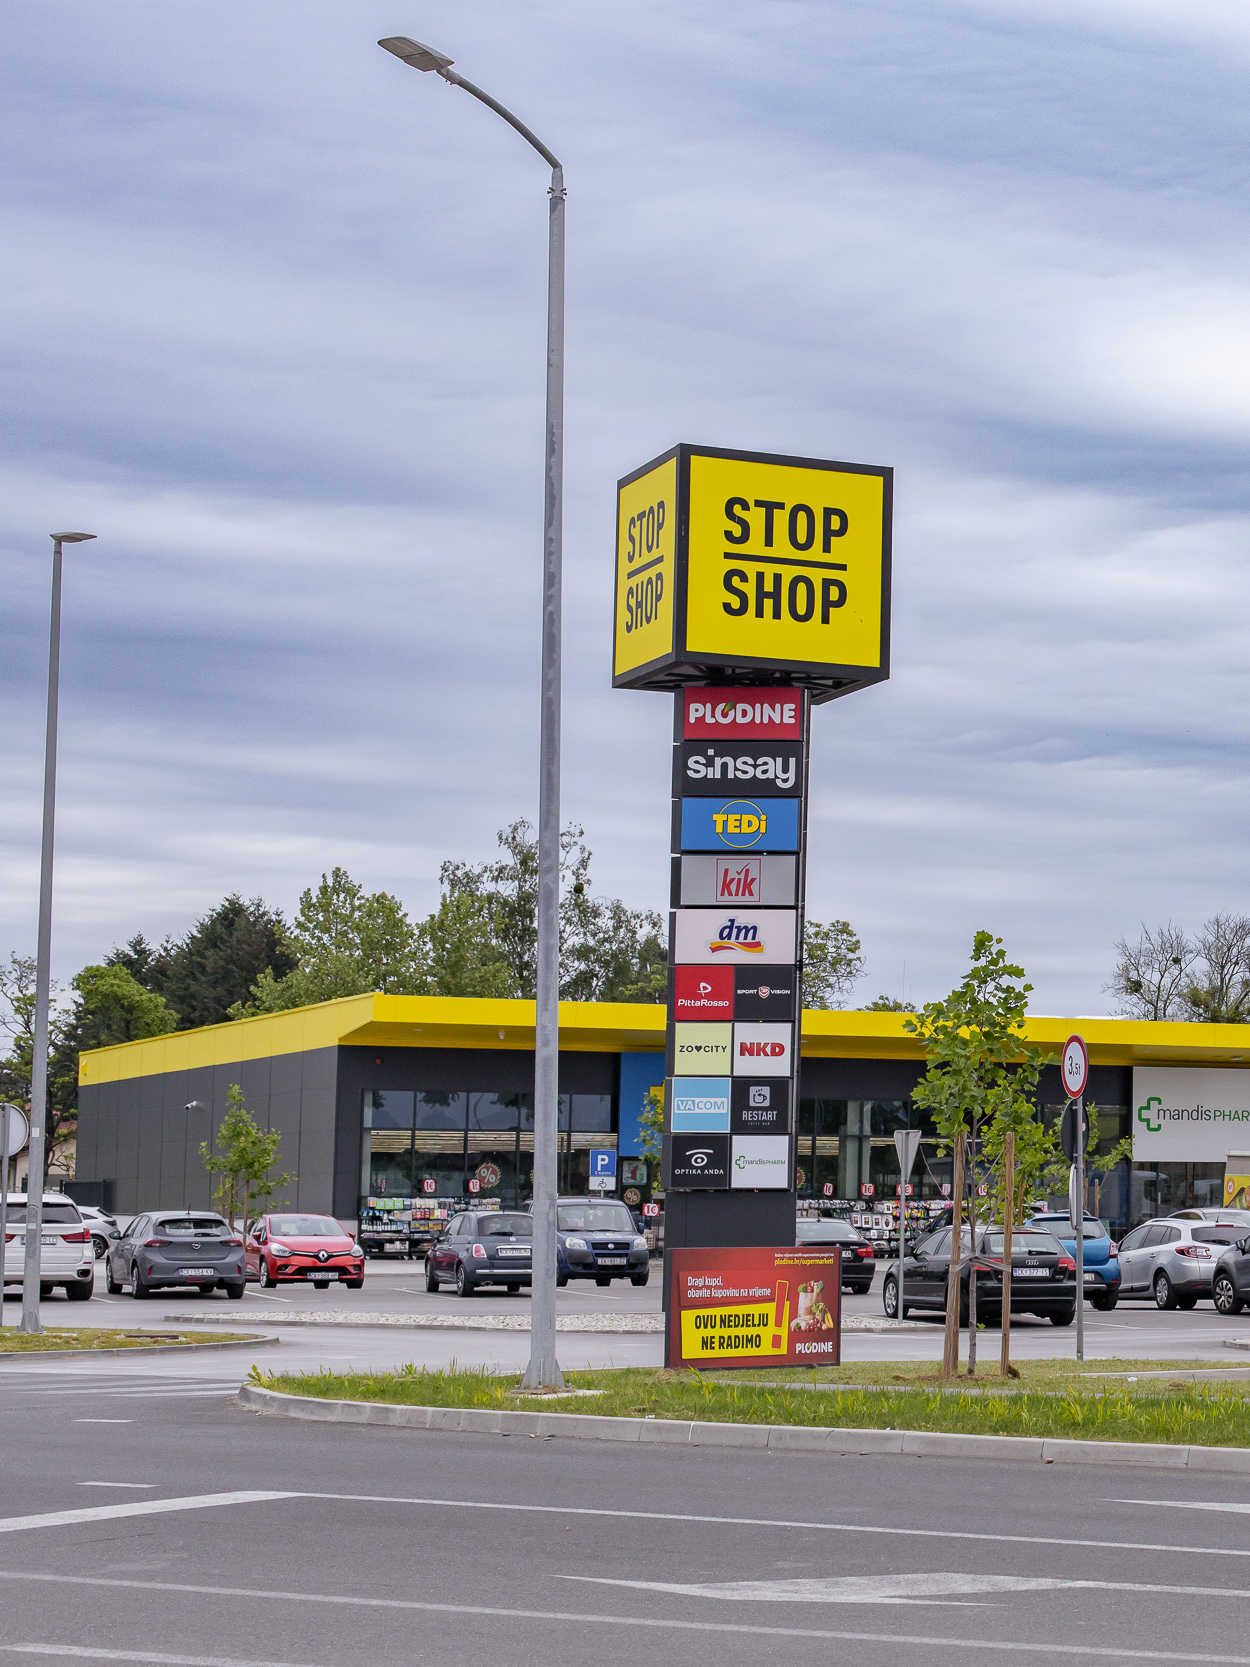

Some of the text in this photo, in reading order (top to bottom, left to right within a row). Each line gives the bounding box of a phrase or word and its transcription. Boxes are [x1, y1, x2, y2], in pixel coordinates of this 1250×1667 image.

[627, 500, 665, 563] STOP
[724, 496, 849, 554] STOP
[625, 571, 664, 633] SHOP
[722, 568, 848, 625] SHOP
[689, 702, 796, 724] PLODINE
[686, 749, 796, 789] sinsay
[712, 814, 768, 834] TEDi
[720, 863, 757, 897] kik
[719, 918, 758, 941] dm
[678, 999, 729, 1007] PittaRosso
[739, 1042, 786, 1057] NKD
[676, 1100, 725, 1111] VACOM
[742, 1111, 777, 1121] RESTART
[597, 1154, 609, 1171] P
[775, 1258, 834, 1266] plodine.hr/supermarketi
[687, 1276, 723, 1287] Dragi kupci,
[687, 1287, 771, 1298] obavite kupovinu na vrijeme
[694, 1313, 769, 1329] OVU NEDJELJU
[701, 1334, 762, 1350] NE RADIMO
[795, 1341, 833, 1354] PLODINE
